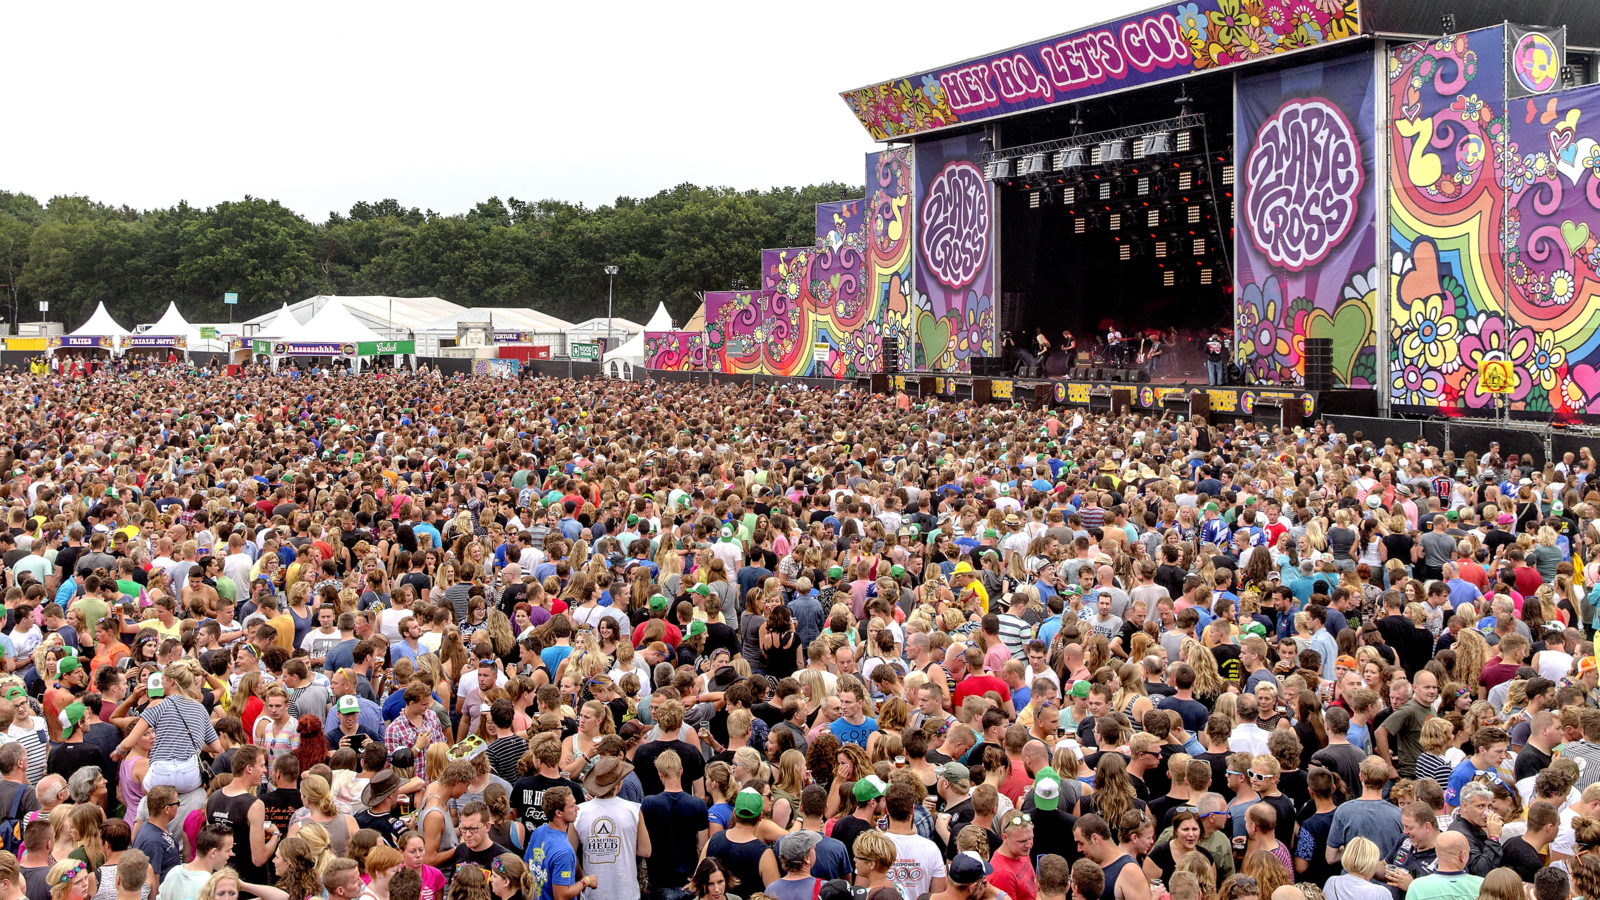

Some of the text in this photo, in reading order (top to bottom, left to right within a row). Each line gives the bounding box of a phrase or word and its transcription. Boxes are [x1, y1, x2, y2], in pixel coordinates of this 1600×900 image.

[940, 13, 1188, 110] HEY HO, LET'S GO!
[1249, 104, 1356, 222] ZWARTE
[925, 167, 987, 251] ZWARTE
[1256, 187, 1349, 262] CROSS
[930, 226, 985, 282] CROSS
[523, 789, 533, 805] DE
[588, 842, 618, 850] HELD
